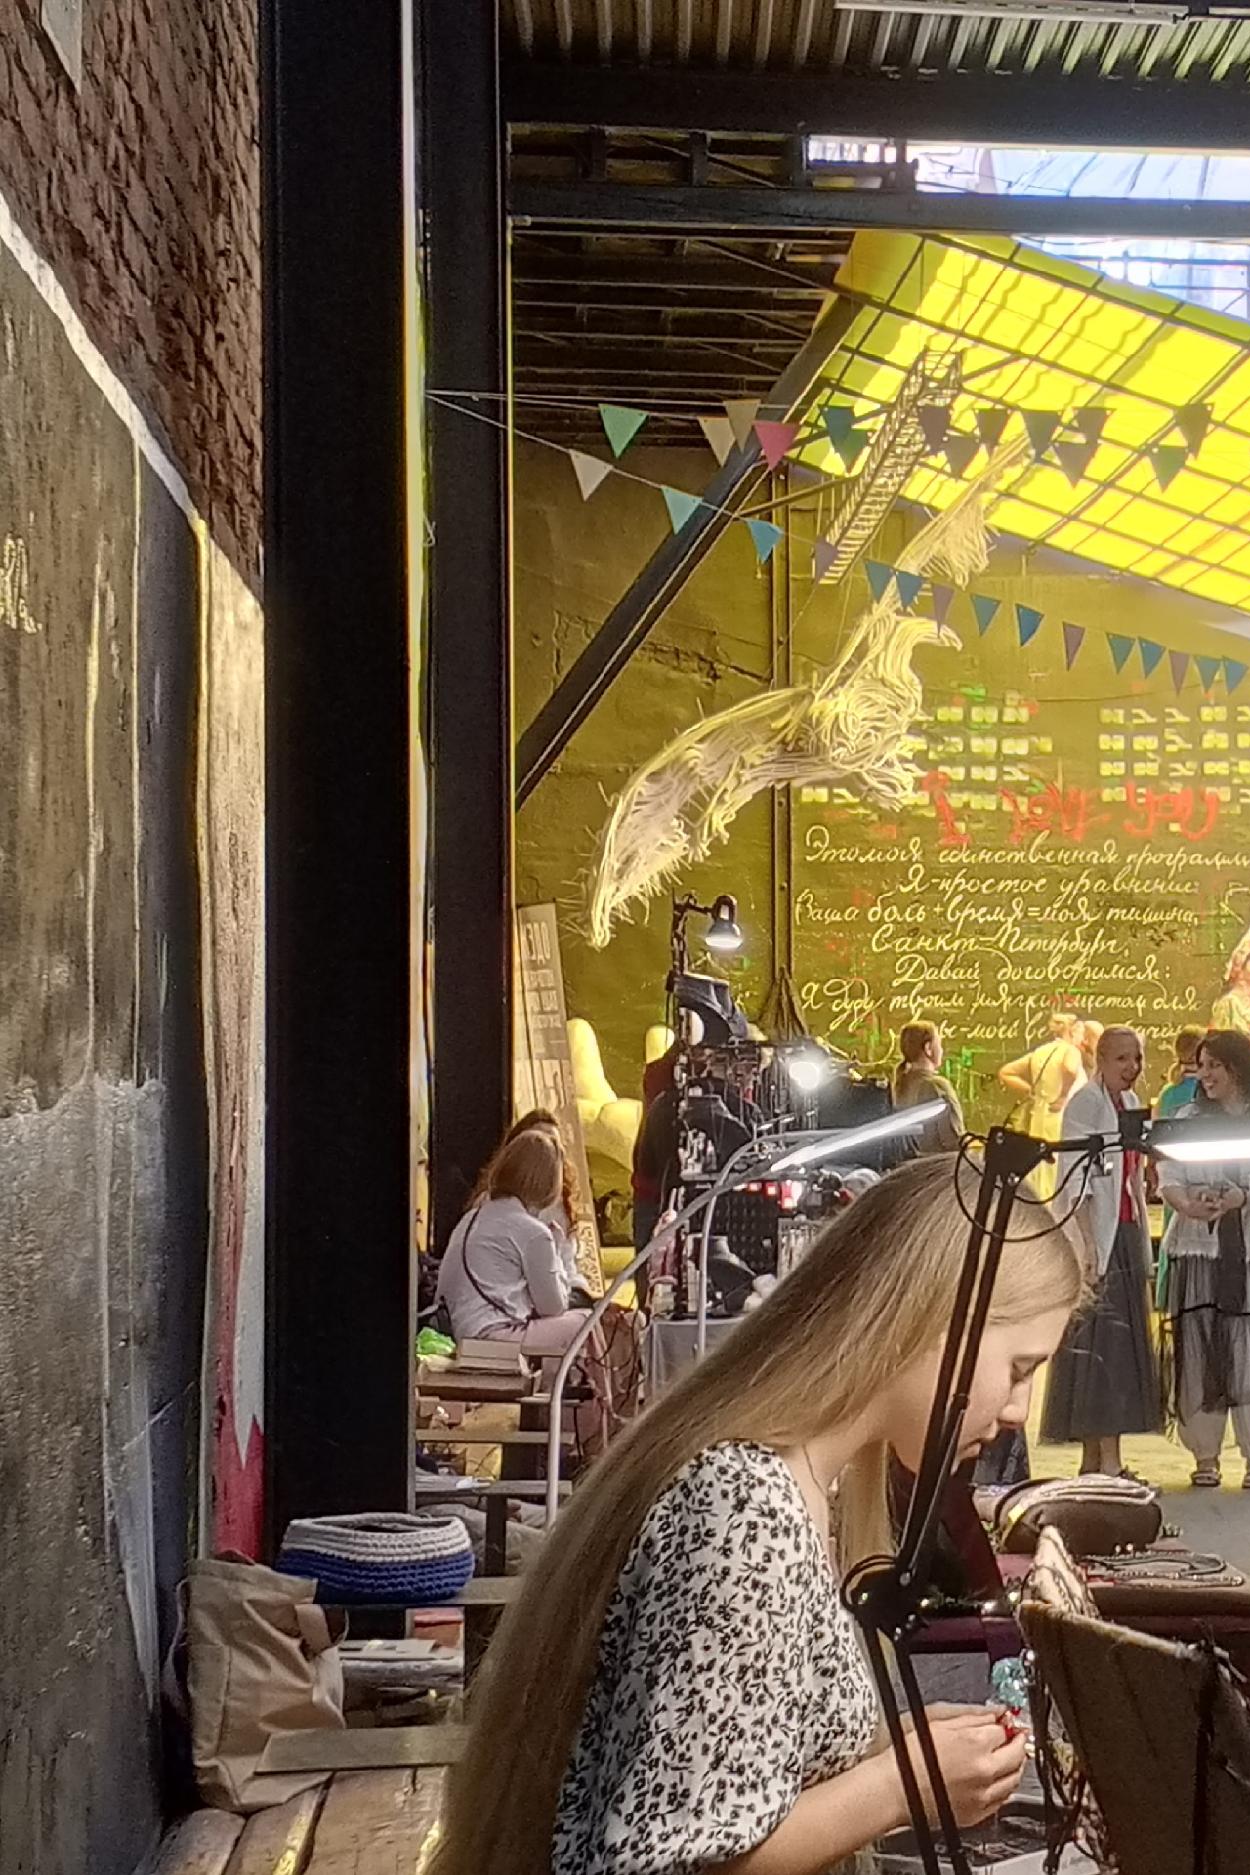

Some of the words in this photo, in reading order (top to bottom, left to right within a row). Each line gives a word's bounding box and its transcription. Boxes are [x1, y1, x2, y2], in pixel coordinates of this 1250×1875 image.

[938, 829, 1120, 864] единственная
[795, 889, 859, 925] Ваша
[892, 953, 980, 988] Давай
[801, 981, 823, 1010] Я
